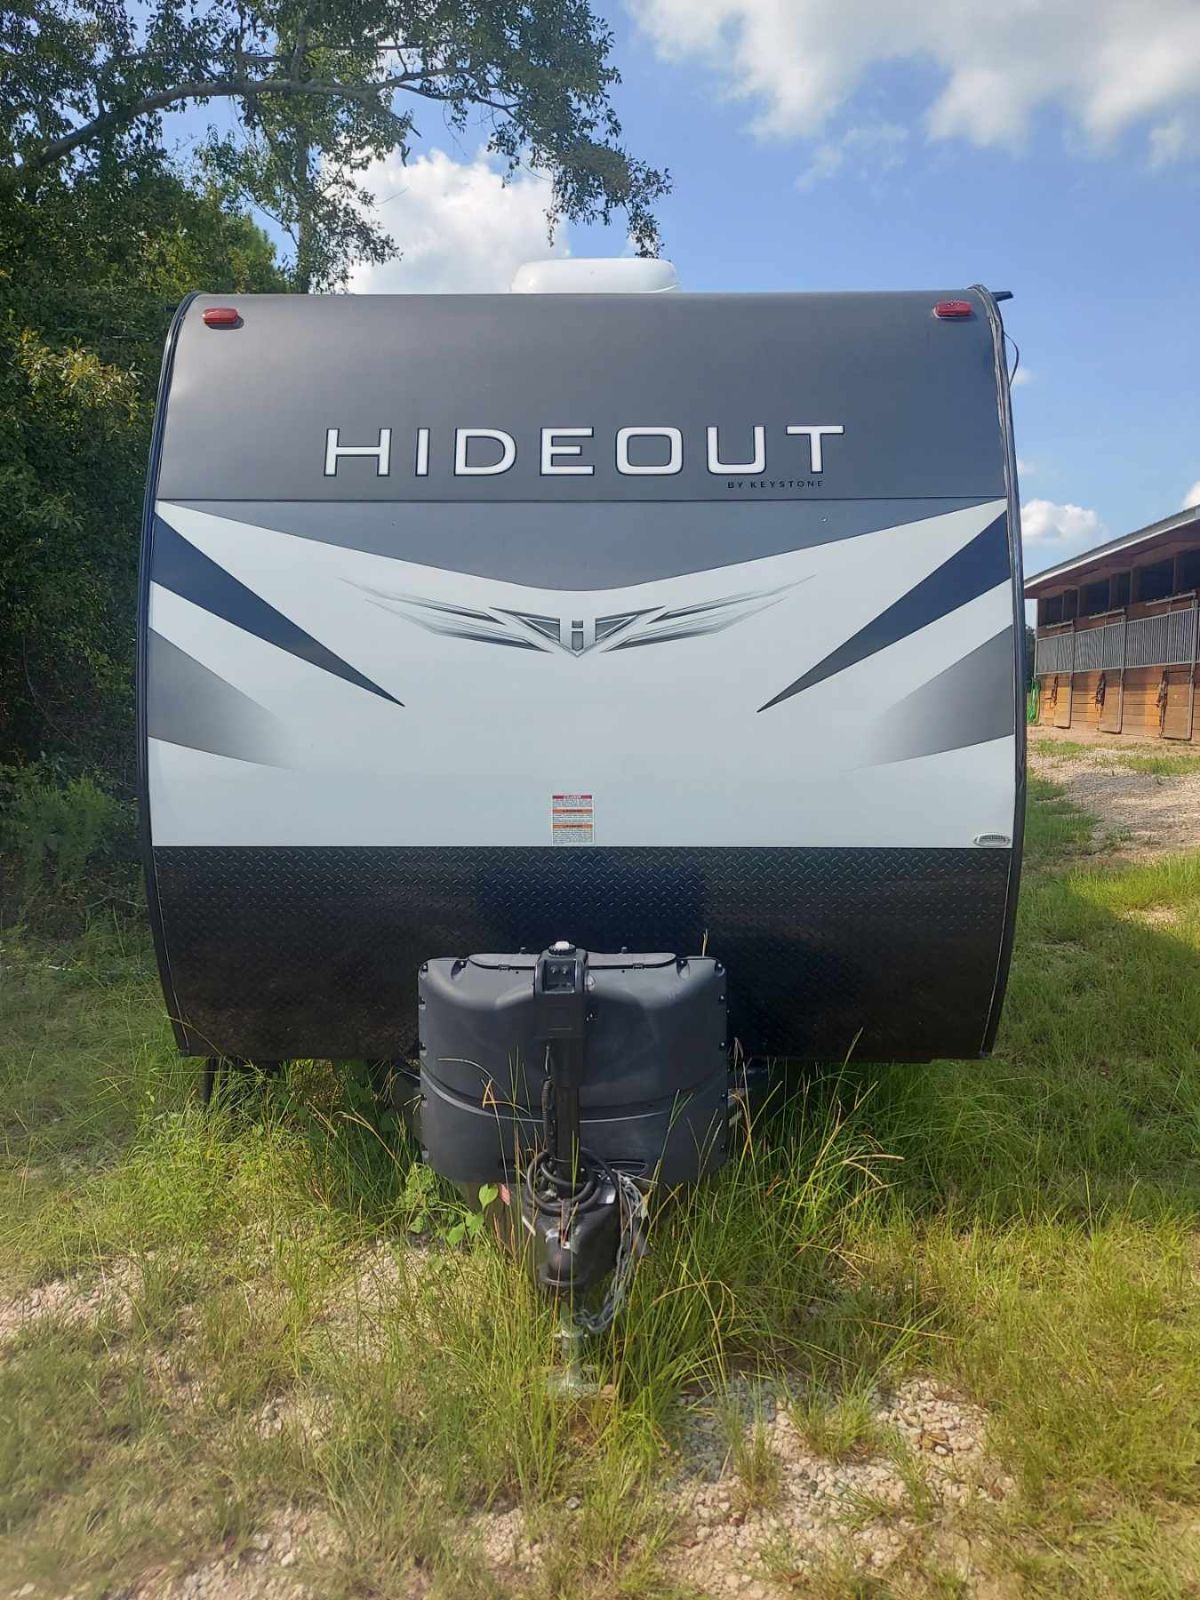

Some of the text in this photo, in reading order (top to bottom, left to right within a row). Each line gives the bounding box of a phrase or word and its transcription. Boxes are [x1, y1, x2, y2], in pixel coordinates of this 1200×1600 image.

[324, 425, 846, 477] HIDEOUT
[727, 480, 823, 489] BY KEYSTONE
